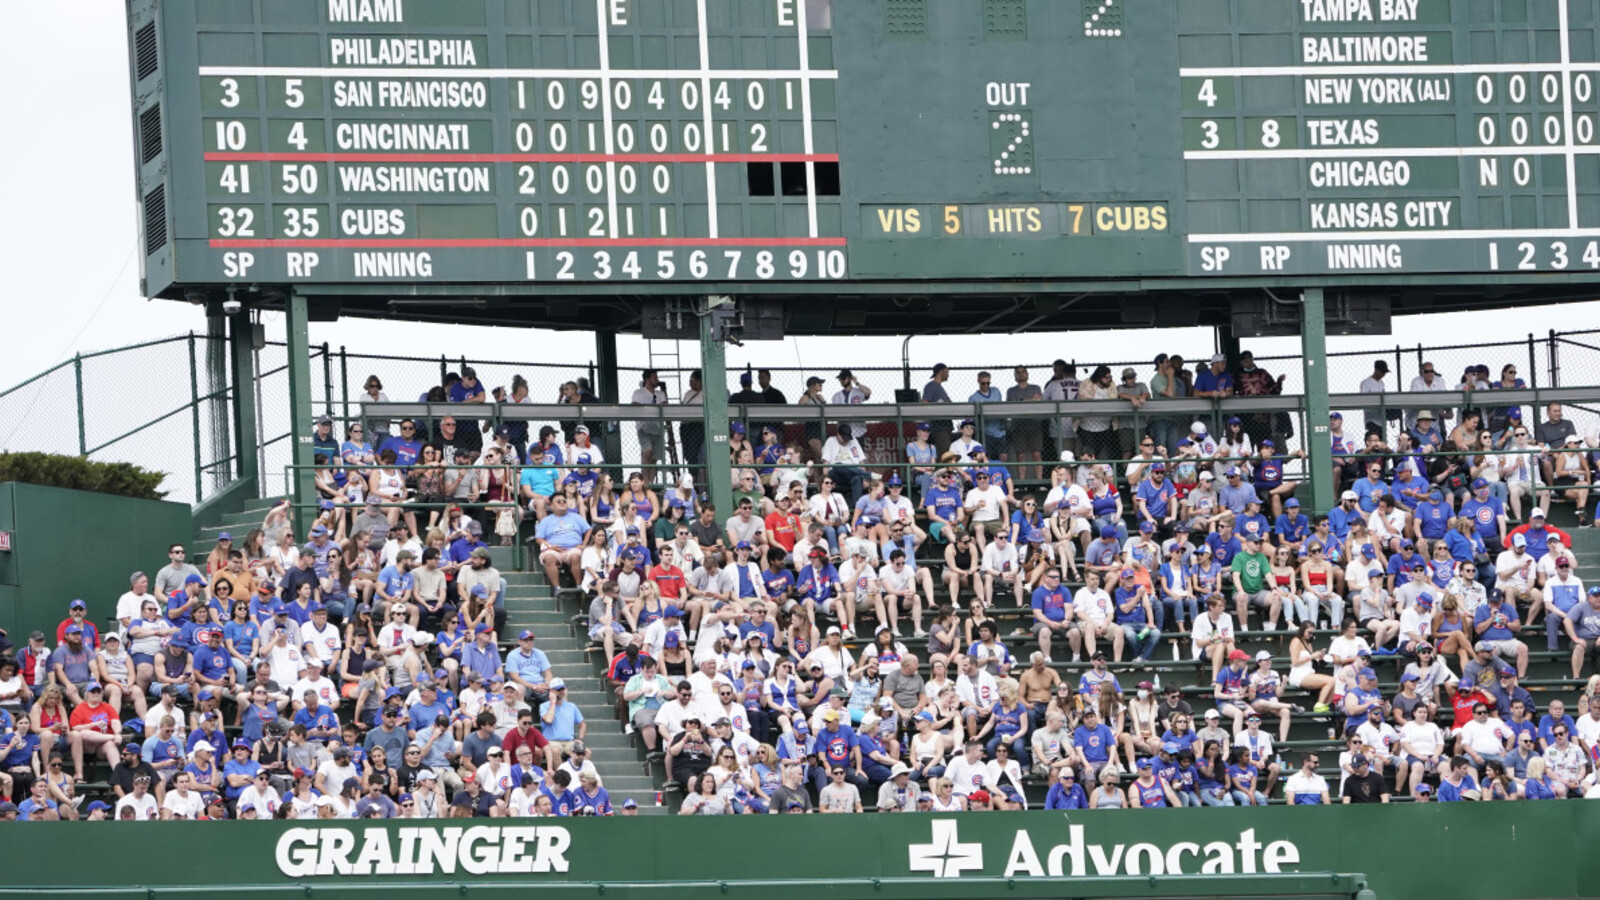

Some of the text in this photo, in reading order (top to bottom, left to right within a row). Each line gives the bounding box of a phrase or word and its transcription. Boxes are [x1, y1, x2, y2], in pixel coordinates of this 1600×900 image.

[329, 0, 403, 22] MIAMI
[1300, 0, 1419, 21] TAMPA BAY
[331, 39, 477, 66] PHILADELPHIA
[1303, 36, 1428, 63] BALTIMORE
[219, 78, 240, 107] 3
[285, 79, 304, 108] 5
[334, 81, 373, 107] SAN
[379, 81, 487, 108] FRANCISCO
[548, 81, 565, 109] 0
[581, 80, 599, 109] 9
[614, 81, 632, 109] 0
[647, 82, 665, 110] 4
[681, 81, 699, 110] 0
[714, 82, 732, 110] 4
[747, 82, 765, 110] 0
[986, 82, 1030, 106] OUT
[1197, 73, 1591, 107] 4 NEW YORK (AL) 0 0 0 0
[215, 121, 247, 150] 10
[287, 122, 308, 150] 4
[336, 123, 470, 150] CINCINNATI
[516, 123, 533, 152] 0
[550, 123, 567, 152] 0
[617, 123, 634, 152] 0
[650, 123, 668, 152] 0
[684, 123, 701, 152] 0
[750, 124, 768, 152] 2
[992, 113, 1031, 174] 2
[1200, 115, 1594, 149] 3 8 TEXAS 0 0 0 0
[219, 165, 670, 195] 41 50 WASHINGTON 2 0 0 0 0
[1309, 158, 1530, 187] CHICAGO N 0
[217, 207, 255, 237] 32
[283, 208, 320, 237] 35
[341, 209, 406, 236] CUBS
[521, 207, 538, 236] 0
[588, 208, 605, 236] 2
[877, 206, 1167, 234] VIS 5 HITS 7 CUBS
[1311, 201, 1452, 228] KANSAS CITY
[223, 252, 255, 277] SP
[287, 252, 320, 277] RP
[353, 252, 433, 277] INNING
[555, 251, 575, 280] 2
[593, 251, 612, 280] 3
[622, 251, 642, 280] 4
[657, 251, 676, 280] 5
[689, 250, 709, 279] 6
[724, 251, 742, 279] 7
[756, 250, 775, 279] 8
[788, 250, 808, 279] 9
[817, 250, 846, 279] 10
[1200, 246, 1230, 271] SP
[1260, 245, 1291, 270] RP
[1327, 243, 1402, 268] INNING
[1518, 242, 1536, 269] 2
[1550, 242, 1569, 269] 3
[1582, 241, 1600, 269] 4
[275, 826, 571, 877] GRAINGER
[1004, 825, 1301, 877] Advocate
